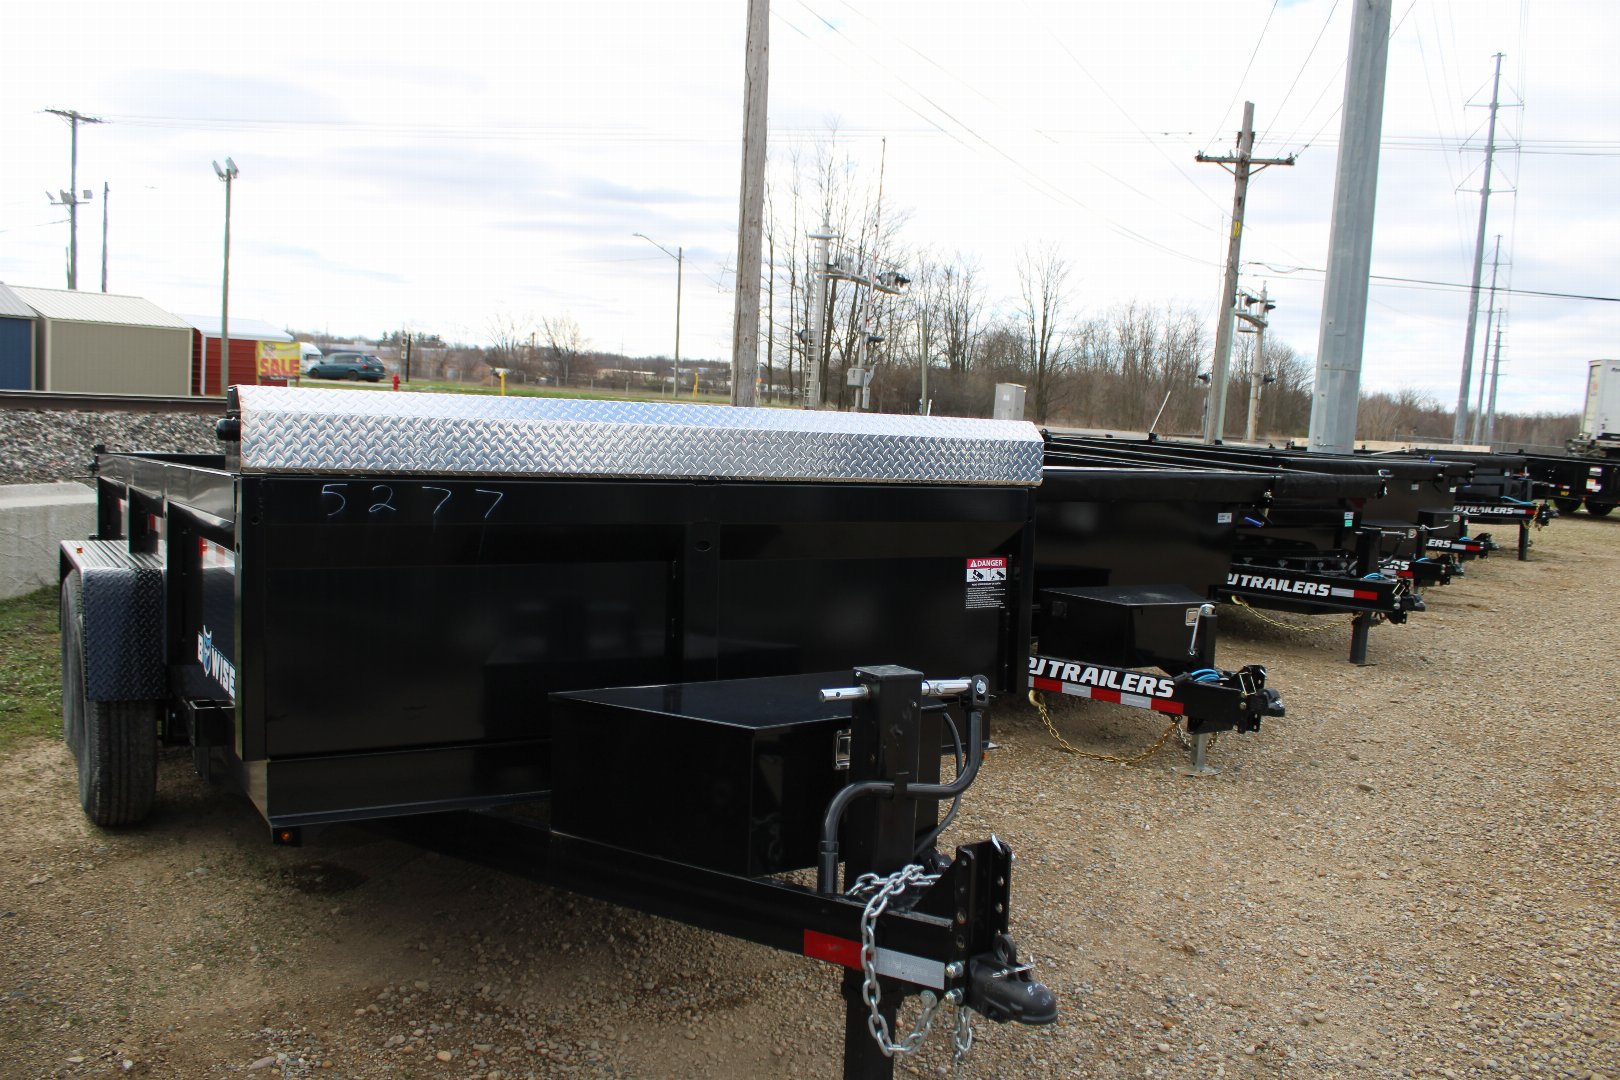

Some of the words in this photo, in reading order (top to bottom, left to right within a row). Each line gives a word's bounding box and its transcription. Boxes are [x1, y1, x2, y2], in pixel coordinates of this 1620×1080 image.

[260, 358, 300, 376] SALE
[321, 483, 504, 519] 5277
[977, 559, 1003, 567] DANGER
[1227, 572, 1240, 585] J
[1240, 574, 1331, 597] TRAILERS
[1048, 660, 1175, 699] TRAILERS
